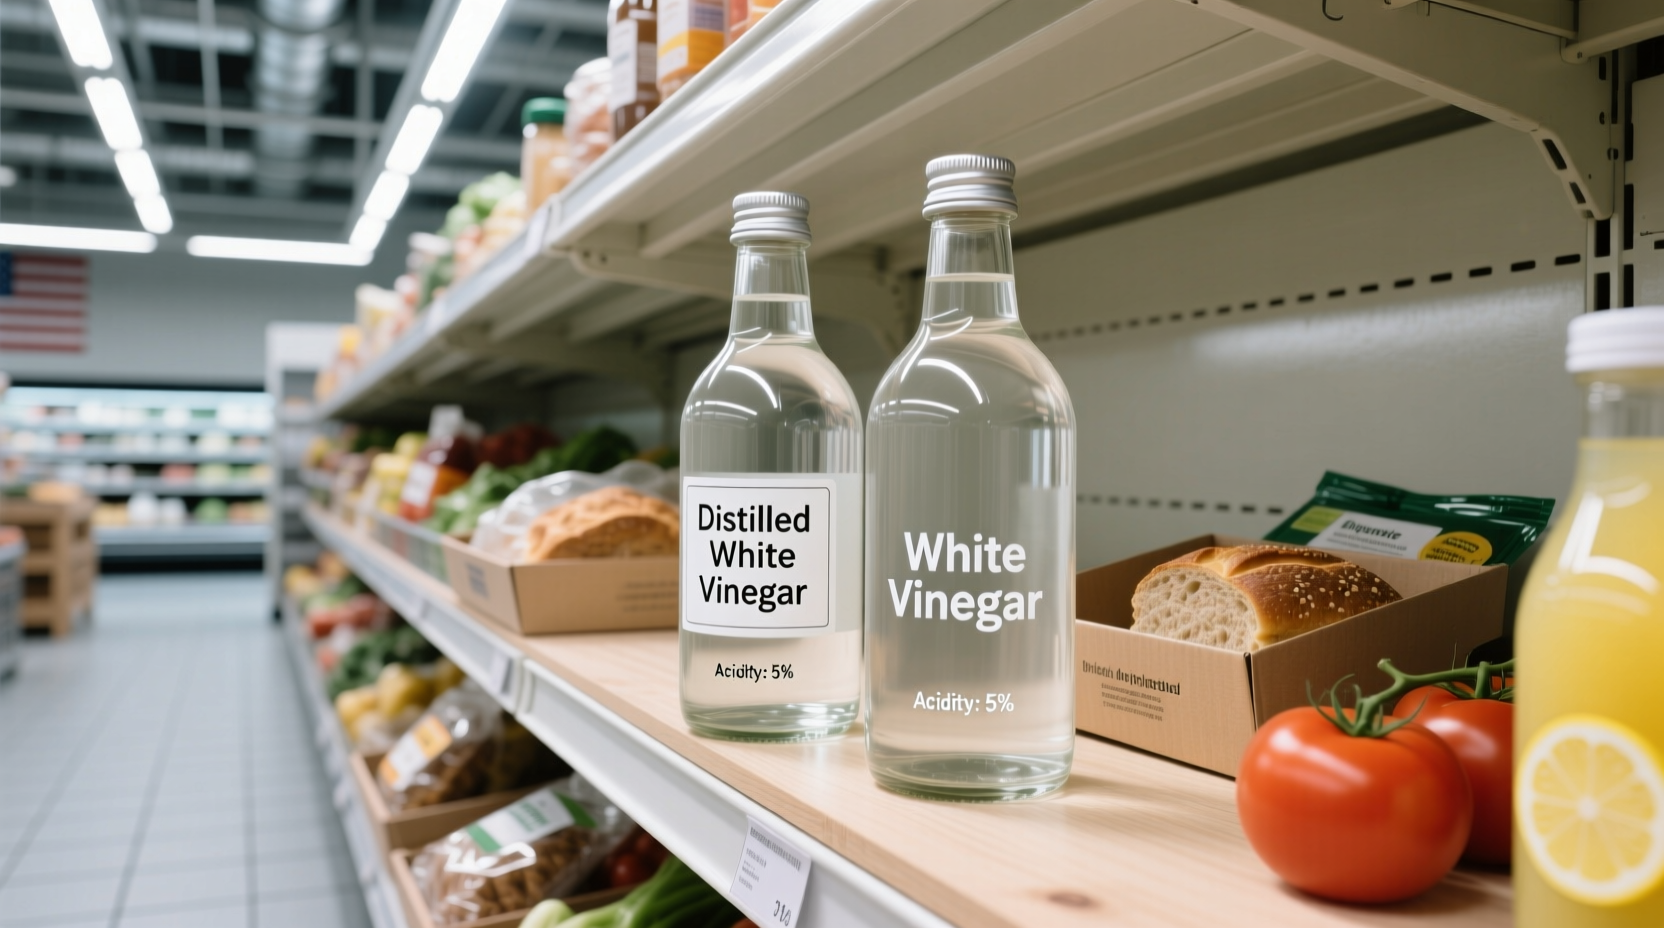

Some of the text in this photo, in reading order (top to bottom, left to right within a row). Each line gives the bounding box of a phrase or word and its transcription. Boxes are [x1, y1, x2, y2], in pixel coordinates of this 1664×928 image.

[698, 503, 810, 533] Distilled
[709, 539, 796, 569] White
[903, 531, 1027, 573] White
[698, 574, 808, 613] Vinegar
[887, 578, 1043, 633] Vinegar
[771, 663, 794, 680] 5%
[913, 690, 1015, 716] Acidity: 5%
